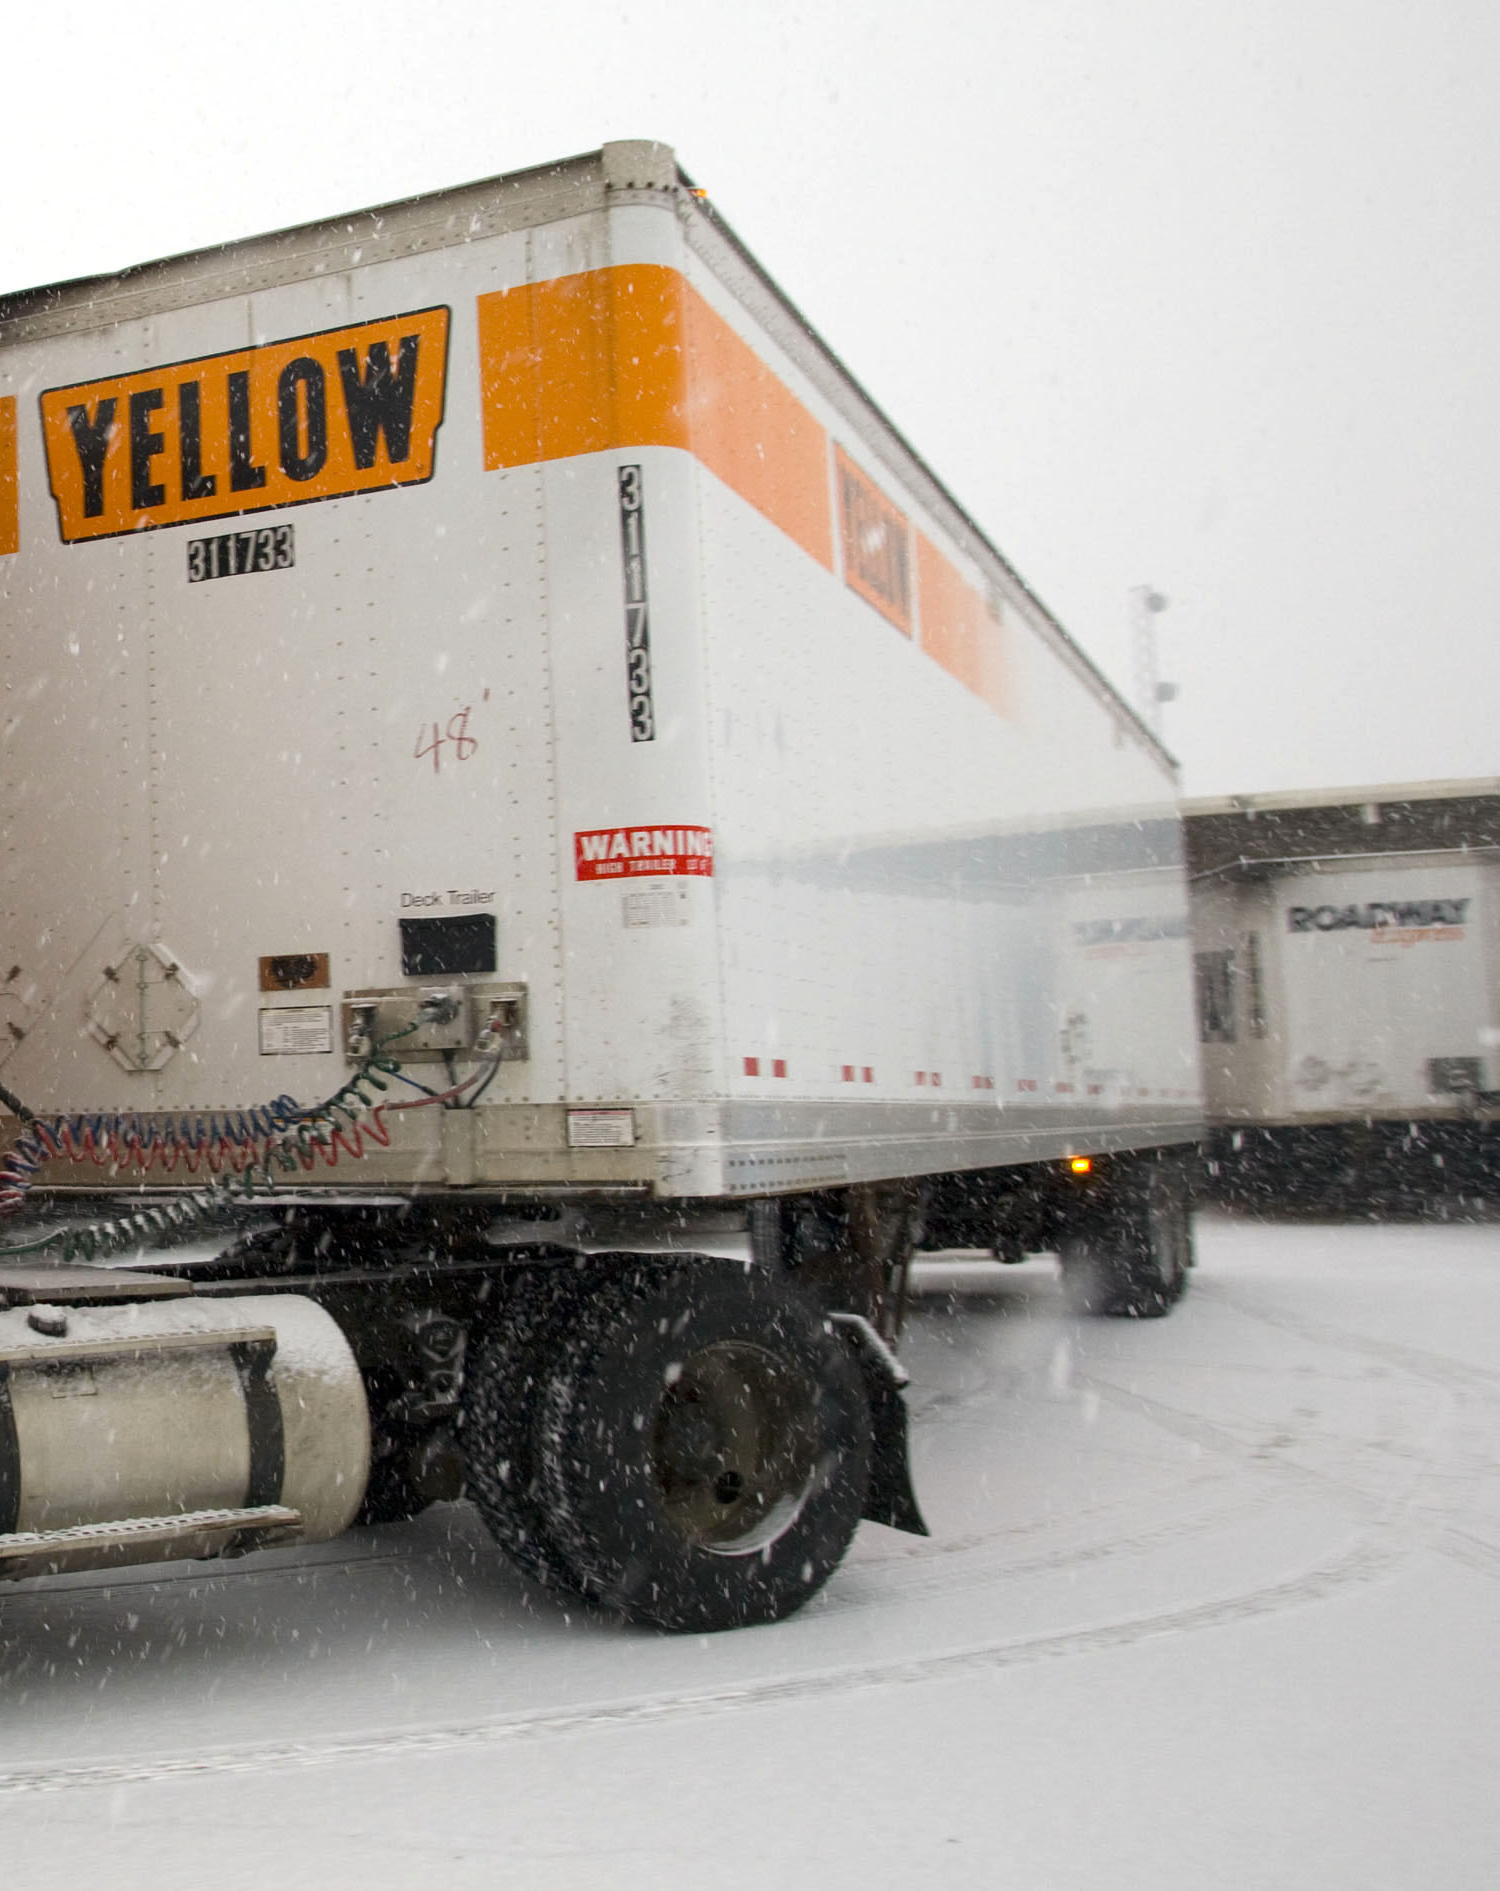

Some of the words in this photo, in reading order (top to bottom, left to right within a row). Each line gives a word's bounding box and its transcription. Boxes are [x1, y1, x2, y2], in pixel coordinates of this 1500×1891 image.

[66, 334, 420, 519] YELLOW
[188, 526, 293, 582] 311733
[619, 465, 653, 741] 311733
[401, 892, 444, 907] Deck
